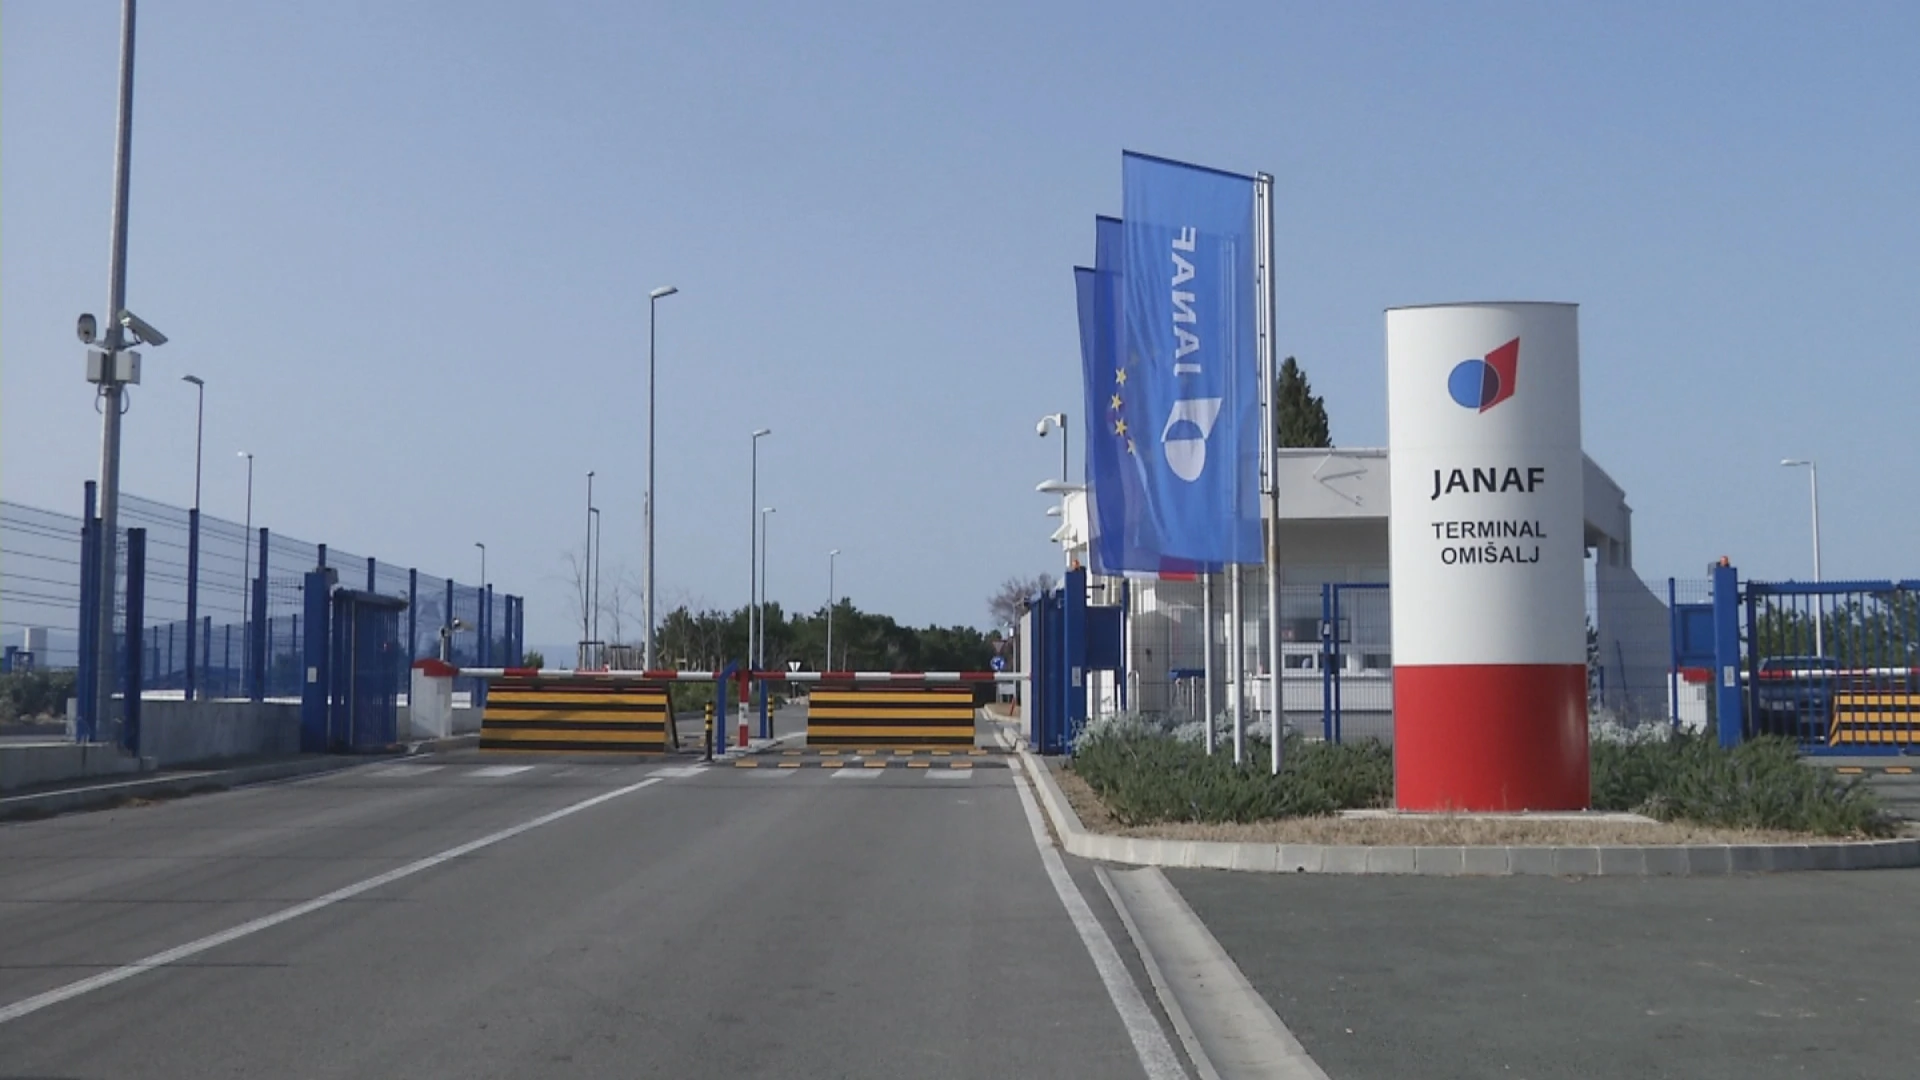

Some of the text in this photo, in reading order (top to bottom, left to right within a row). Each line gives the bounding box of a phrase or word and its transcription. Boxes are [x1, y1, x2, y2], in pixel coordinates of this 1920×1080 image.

[1431, 467, 1545, 501] JANAF
[1432, 520, 1547, 539] TERMINAL
[1441, 541, 1540, 565] OMIŠALJ
